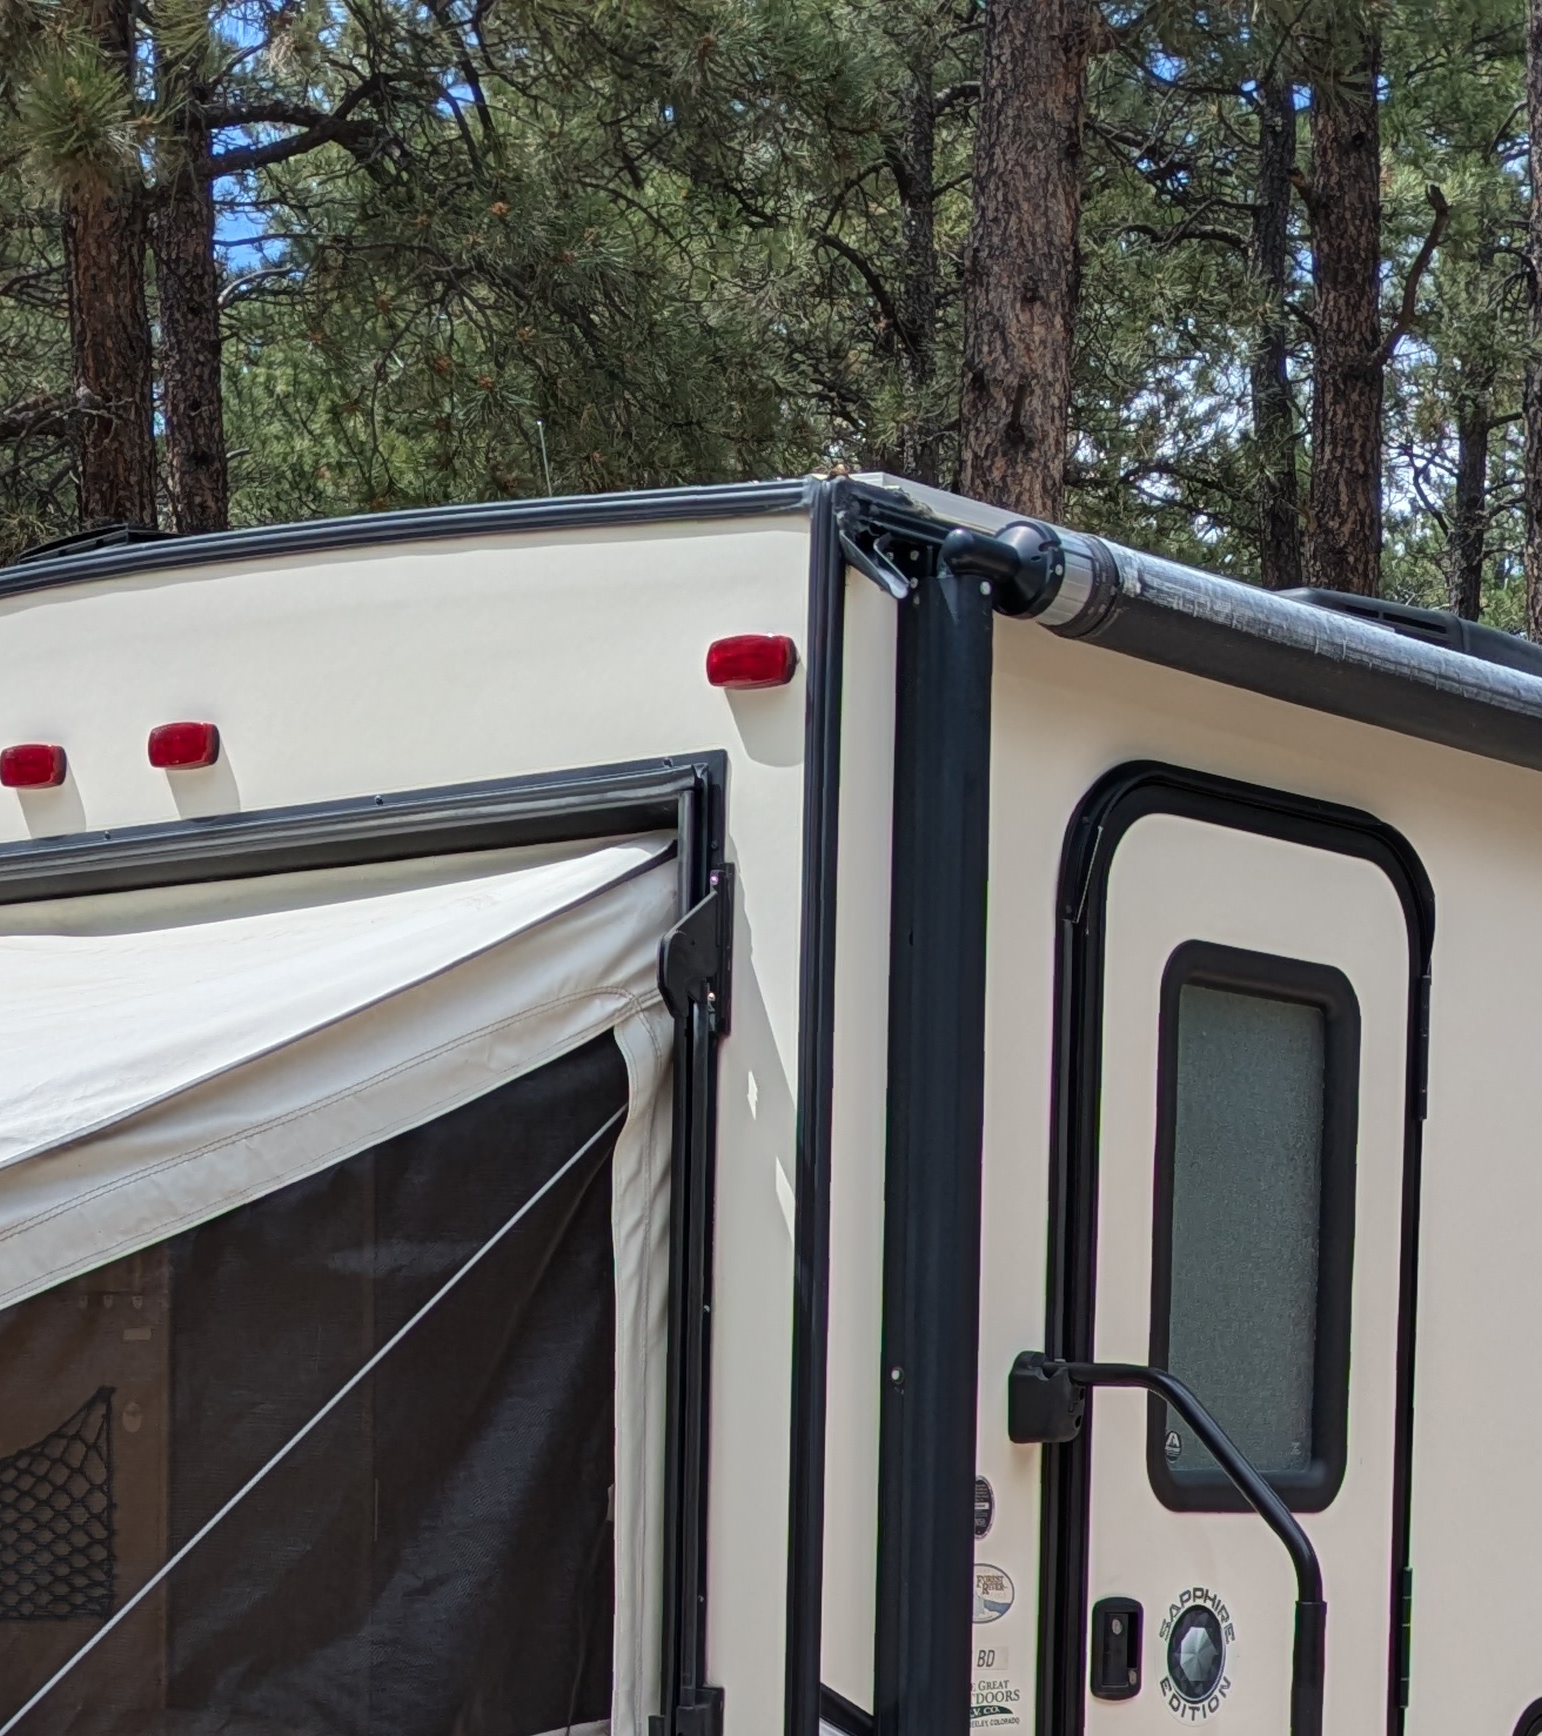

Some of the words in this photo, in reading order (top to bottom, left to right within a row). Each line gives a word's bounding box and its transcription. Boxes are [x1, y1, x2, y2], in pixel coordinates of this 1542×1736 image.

[1159, 1587, 1236, 1645] SAPPHIRE
[977, 1649, 996, 1667] BD
[978, 1680, 1010, 1691] GREAT
[1160, 1676, 1232, 1721] EDITION
